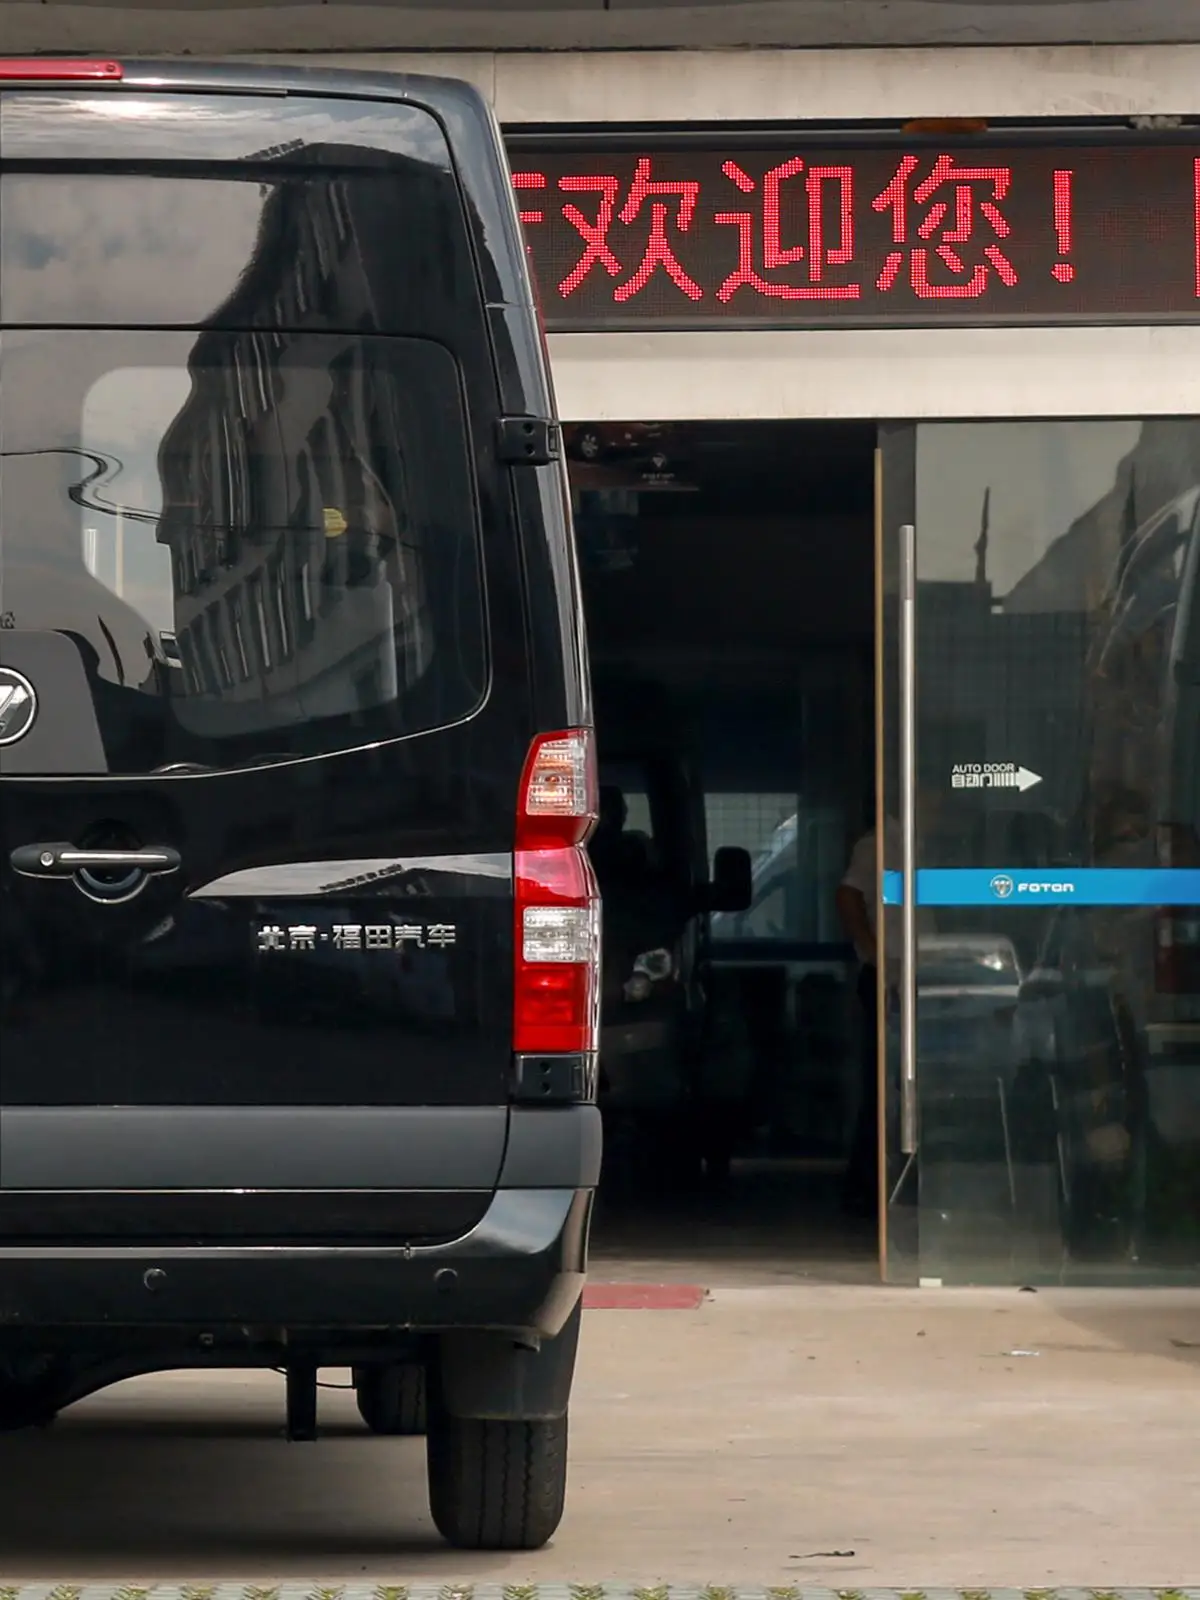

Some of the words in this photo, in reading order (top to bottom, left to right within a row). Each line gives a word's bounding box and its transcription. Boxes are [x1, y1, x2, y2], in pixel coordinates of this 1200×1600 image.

[951, 763, 981, 773] AUTO
[983, 762, 1015, 773] DOOR
[951, 773, 993, 788] 自动门
[1017, 882, 1075, 893] FOTON
